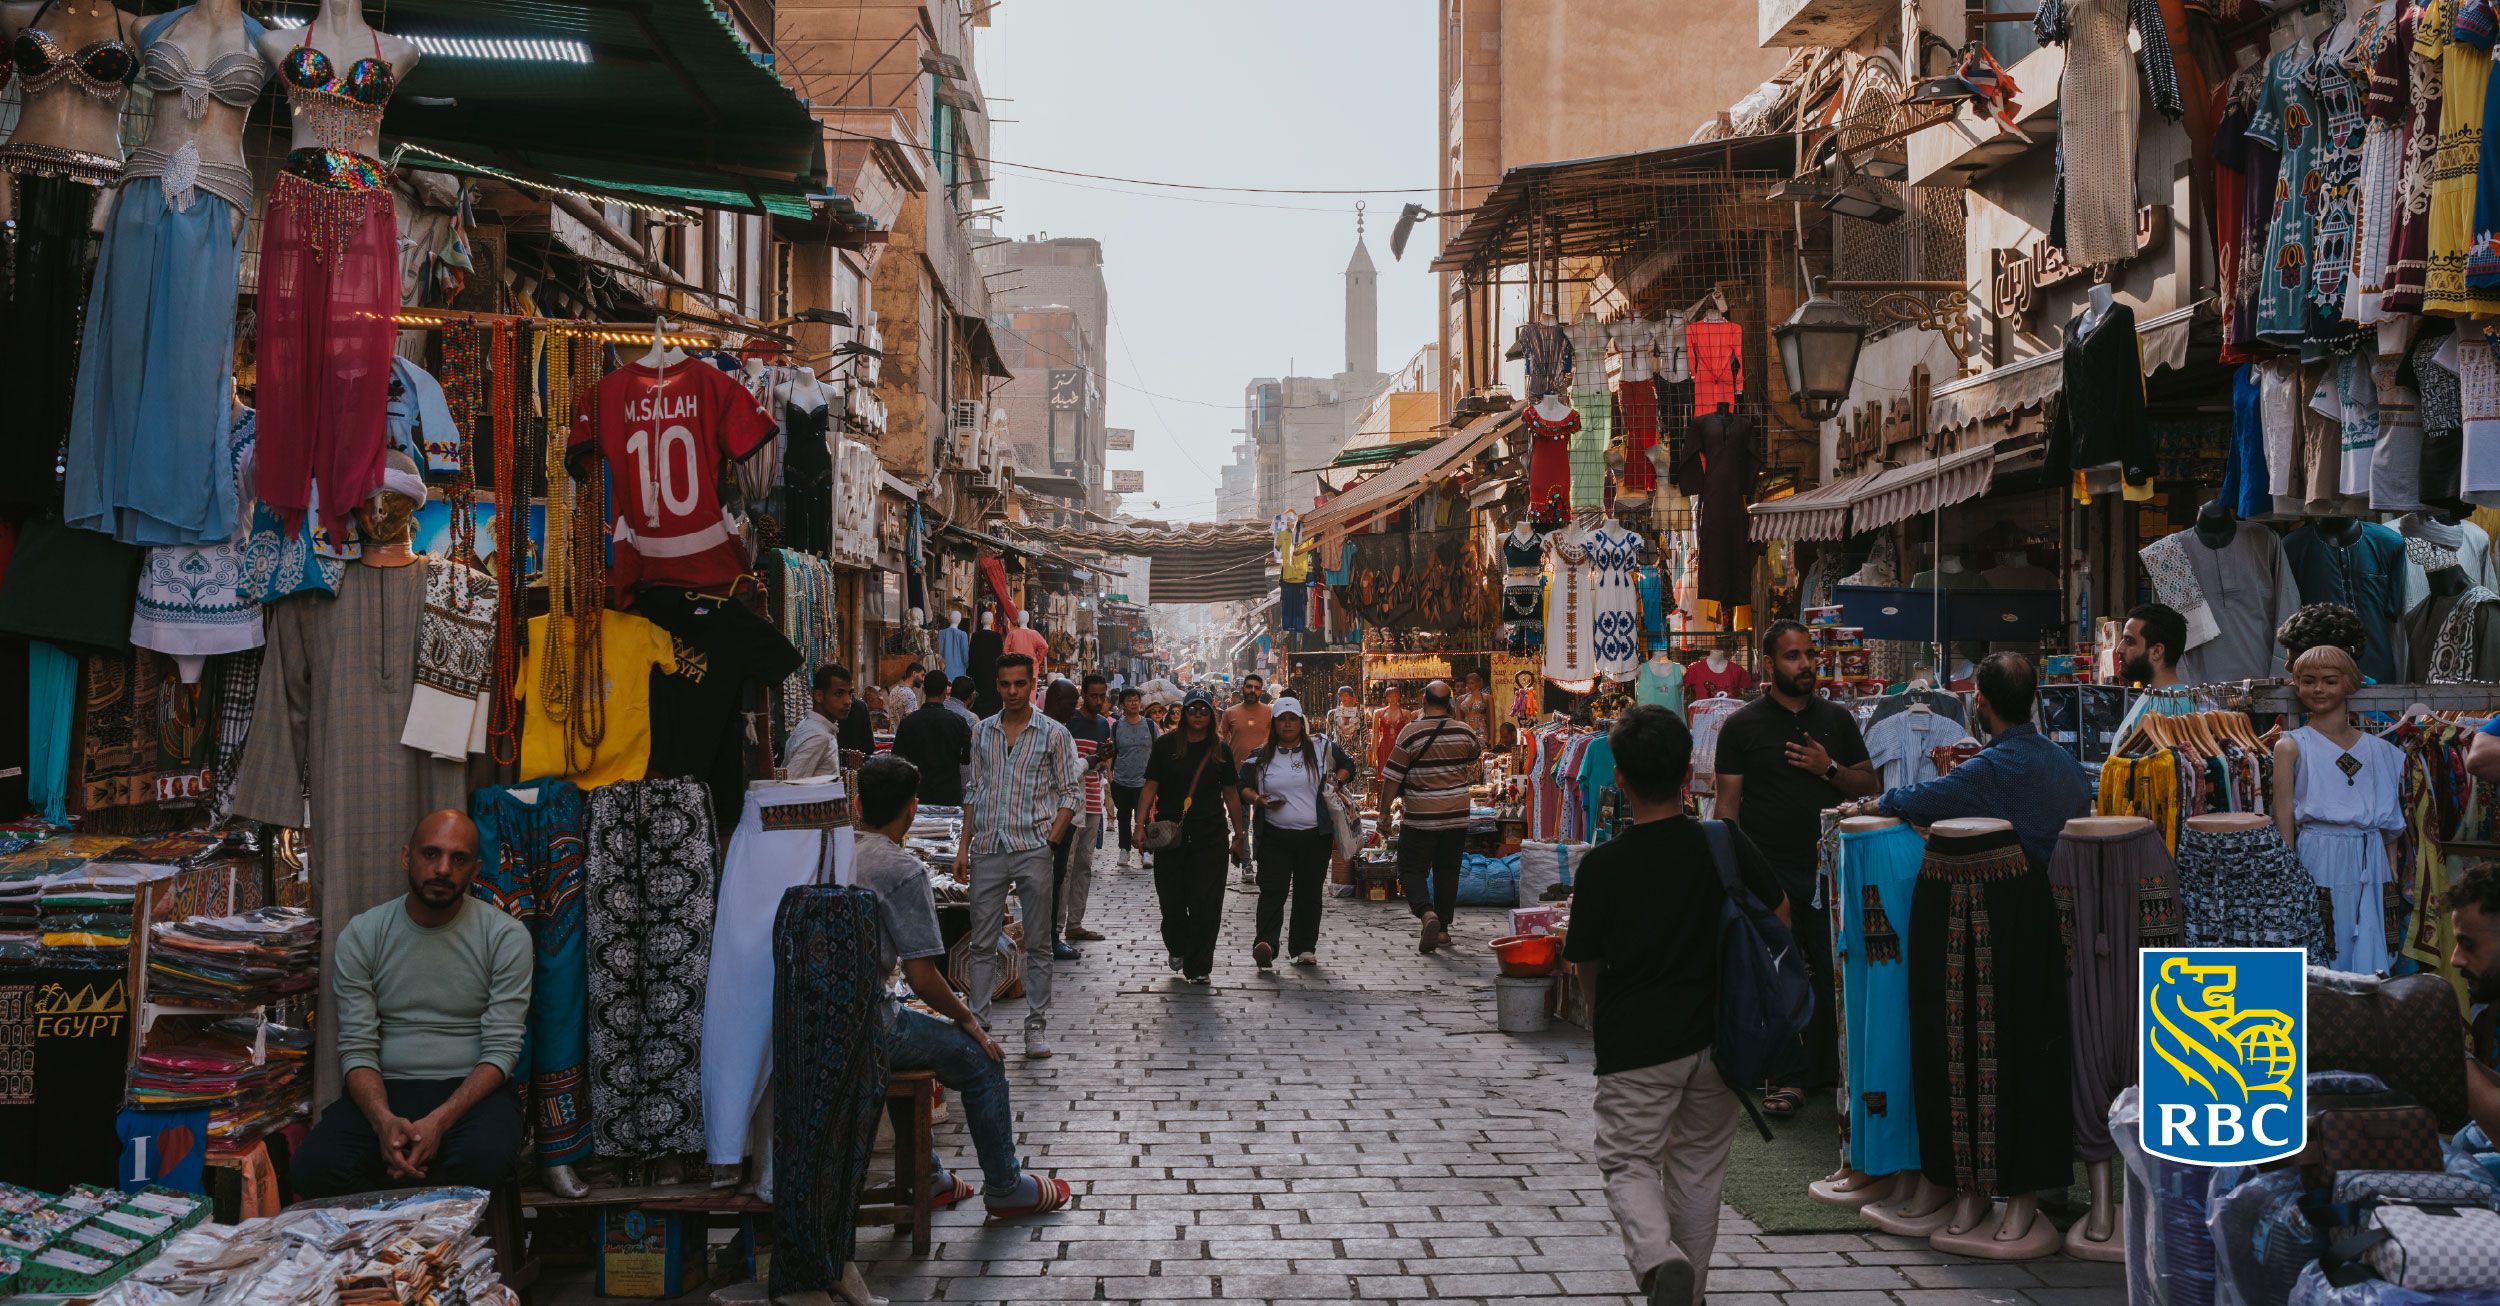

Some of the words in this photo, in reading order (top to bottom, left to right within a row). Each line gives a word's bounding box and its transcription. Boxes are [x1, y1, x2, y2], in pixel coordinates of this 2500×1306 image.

[624, 395, 697, 423] M.SALAH
[626, 425, 699, 517] 10
[37, 1014, 125, 1039] EGYPT
[130, 1135, 152, 1182] I
